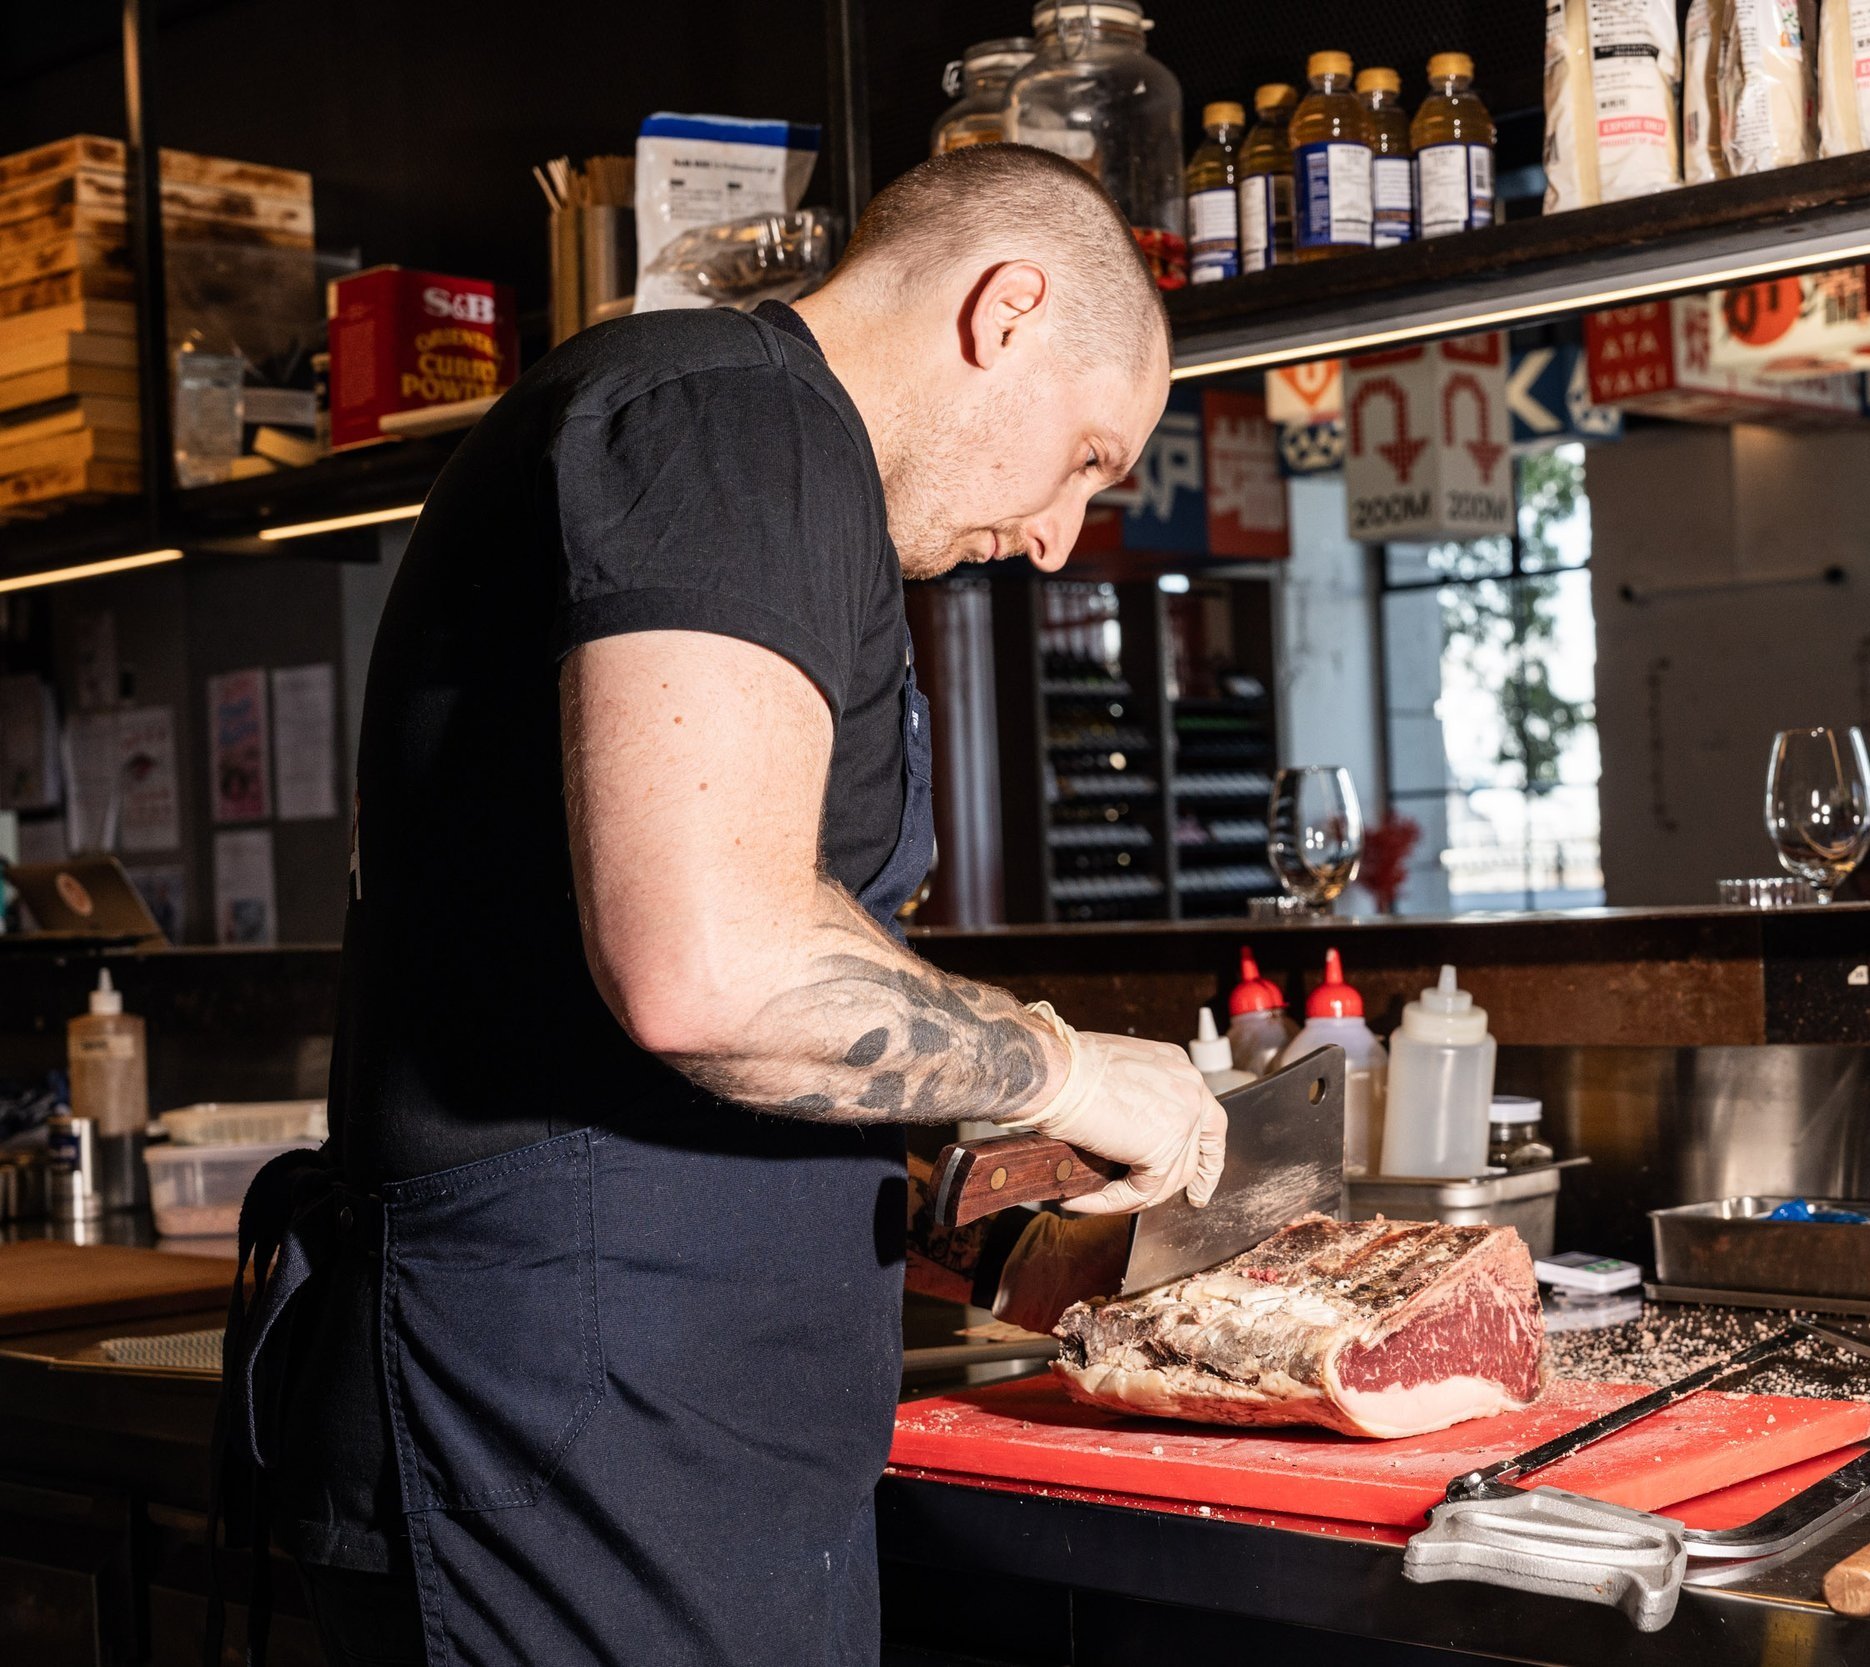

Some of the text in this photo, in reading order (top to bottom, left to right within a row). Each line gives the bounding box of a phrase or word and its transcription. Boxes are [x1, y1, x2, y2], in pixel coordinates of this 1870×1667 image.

[423, 287, 496, 325] S&B
[1601, 331, 1660, 360] ATA
[1595, 363, 1669, 396] YAKI
[1355, 490, 1431, 528] 200M
[1447, 489, 1508, 521] 200M
